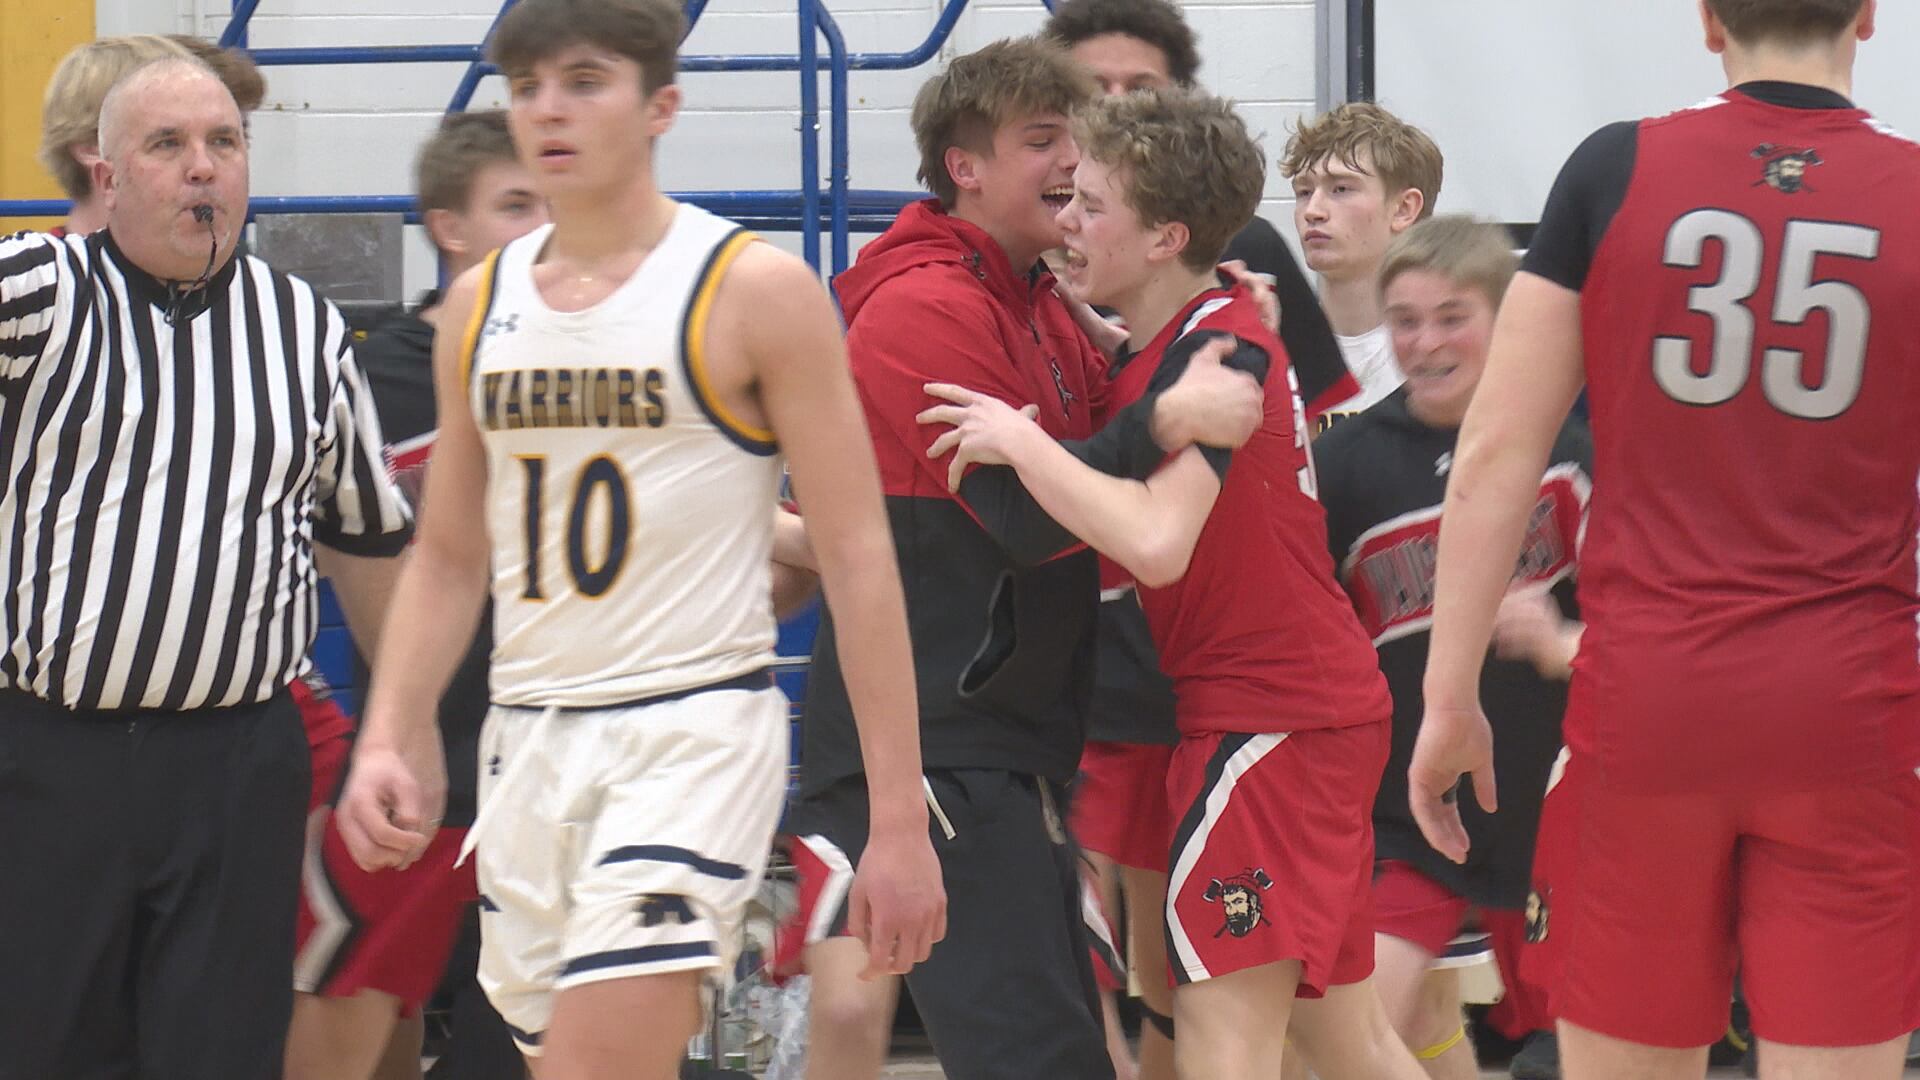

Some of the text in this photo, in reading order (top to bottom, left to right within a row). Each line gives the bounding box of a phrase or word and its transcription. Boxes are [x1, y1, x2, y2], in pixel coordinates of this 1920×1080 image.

[1652, 206, 1880, 422] 35
[481, 368, 666, 430] WARRIORS
[511, 453, 633, 601] 10
